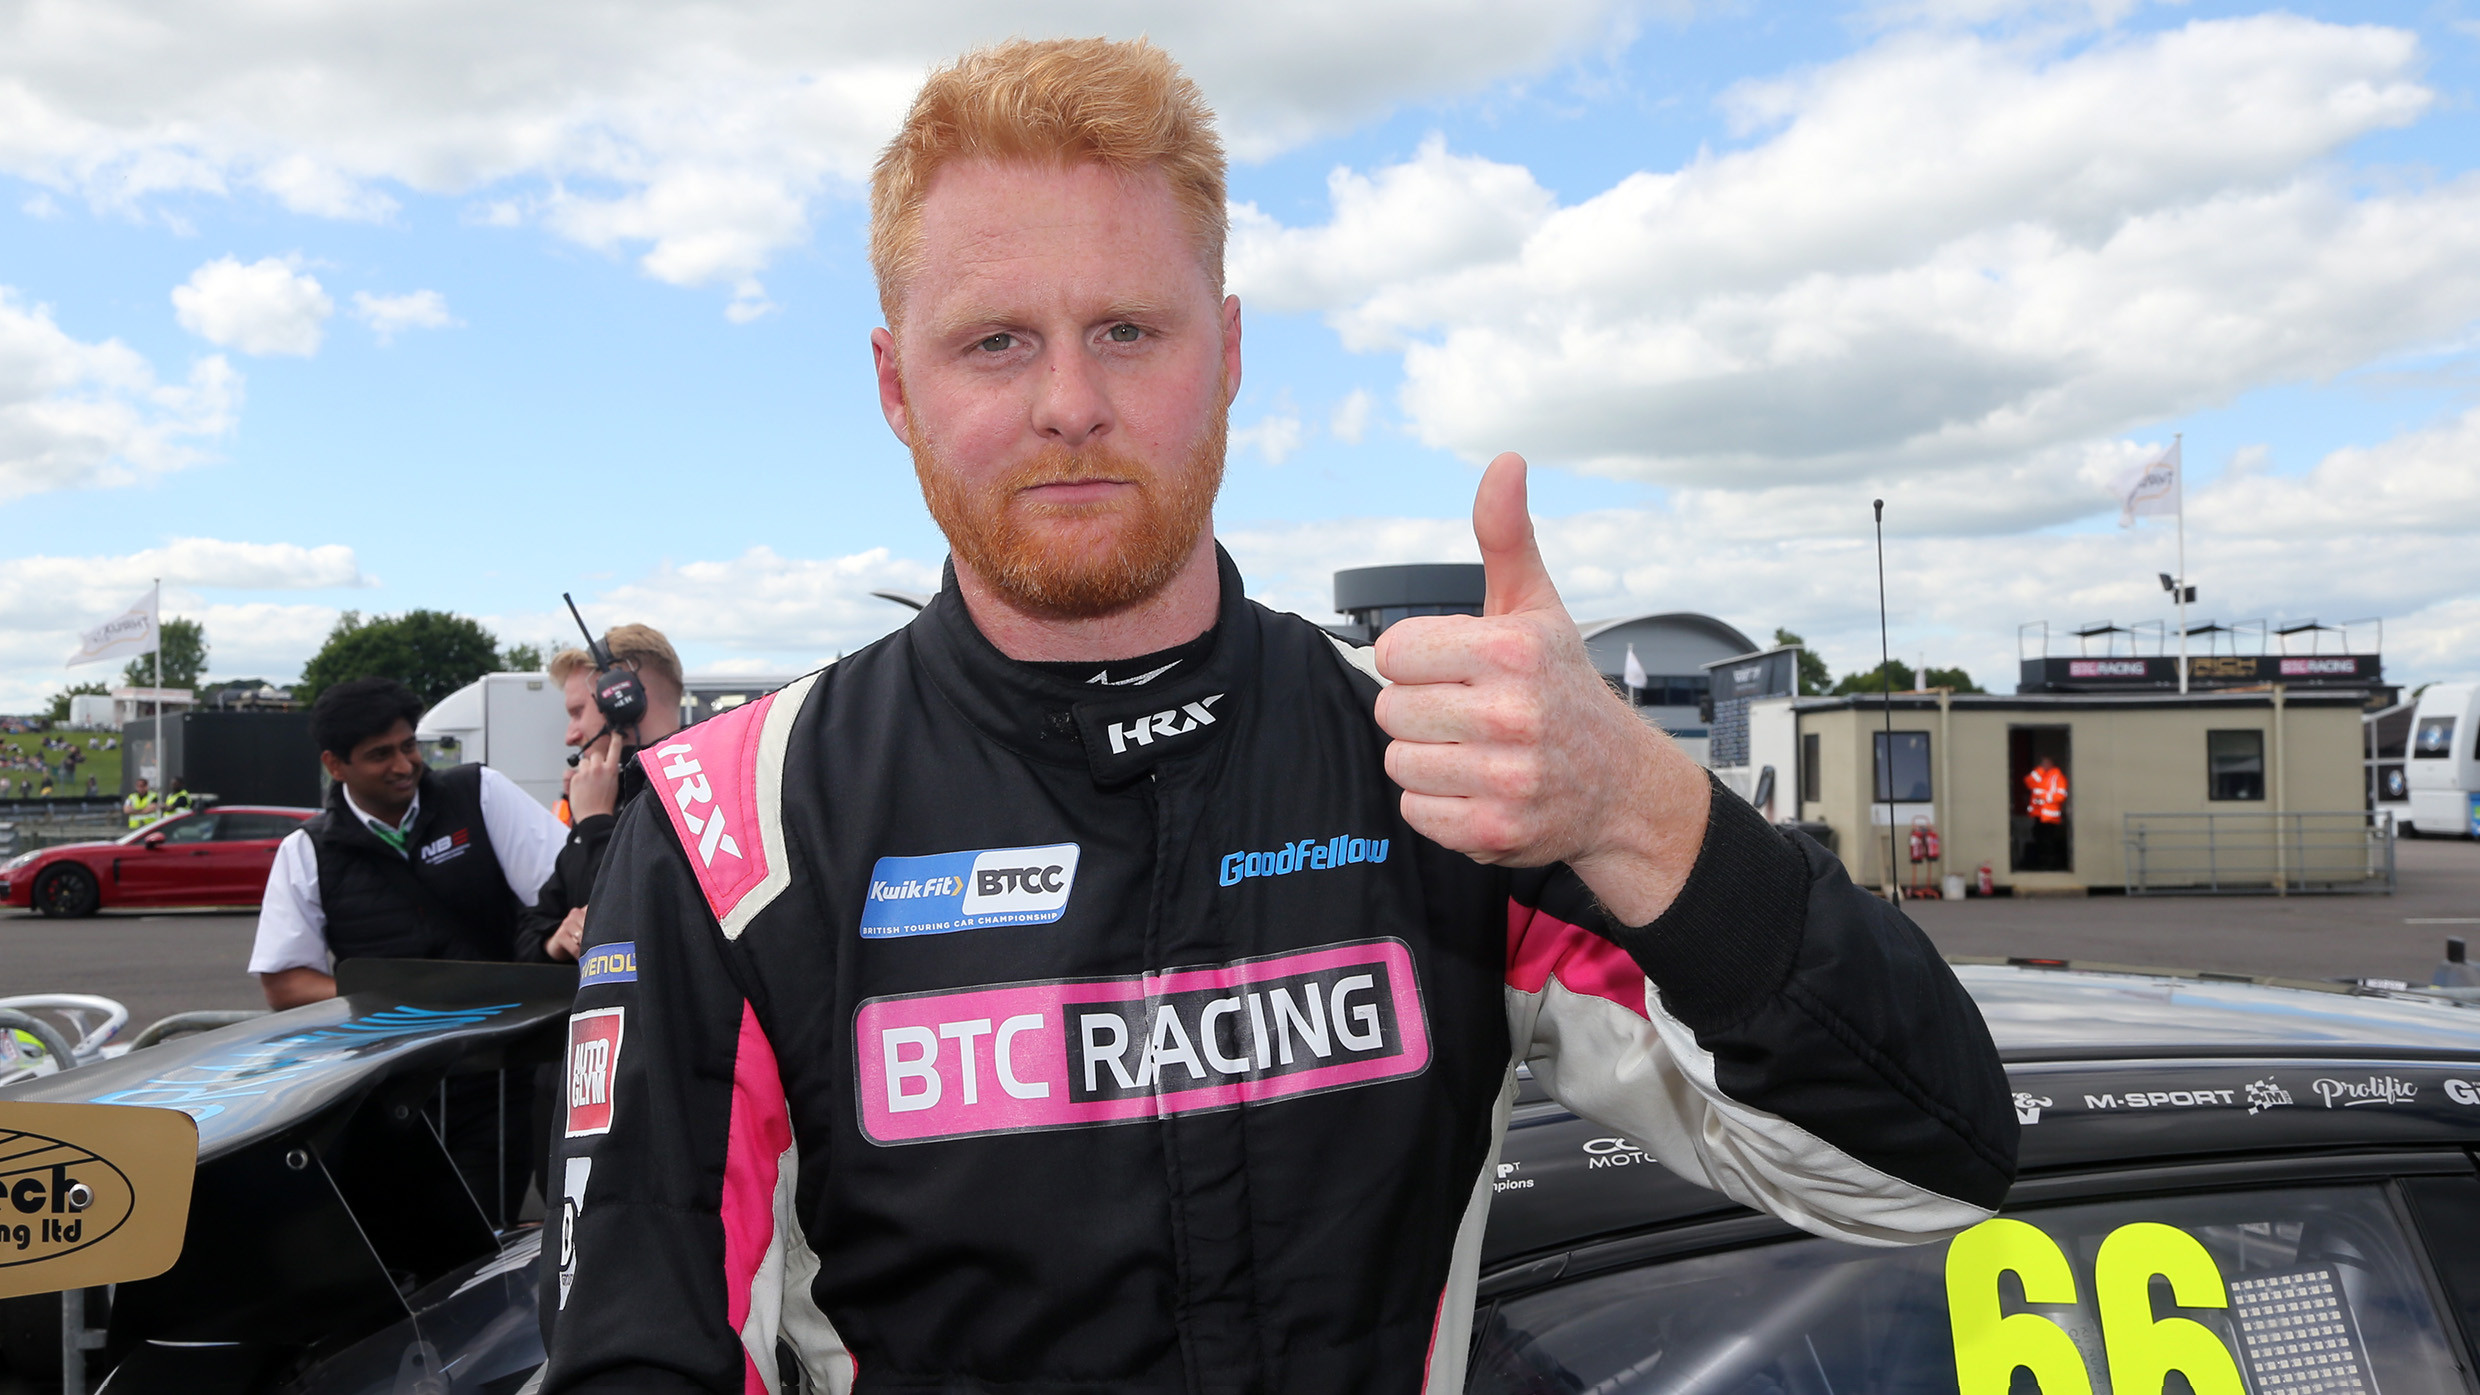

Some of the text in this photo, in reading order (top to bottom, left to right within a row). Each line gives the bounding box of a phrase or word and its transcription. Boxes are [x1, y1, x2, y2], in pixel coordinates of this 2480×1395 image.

[1107, 693, 1225, 755] HRX
[656, 743, 744, 869] HRX
[976, 864, 1065, 897] BTCC
[863, 912, 1058, 935] BRITISH TOURING CAR CHAMPIONSHIP
[581, 953, 637, 979] VENOL
[573, 1038, 610, 1076] AUTO
[882, 974, 1383, 1114] BTC RACING
[572, 1070, 607, 1108] GLYM
[2083, 1090, 2235, 1109] M-SPORT
[2312, 1076, 2419, 1108] Prolific
[42, 1219, 82, 1243] ltd
[1945, 1218, 2246, 1395] 66
